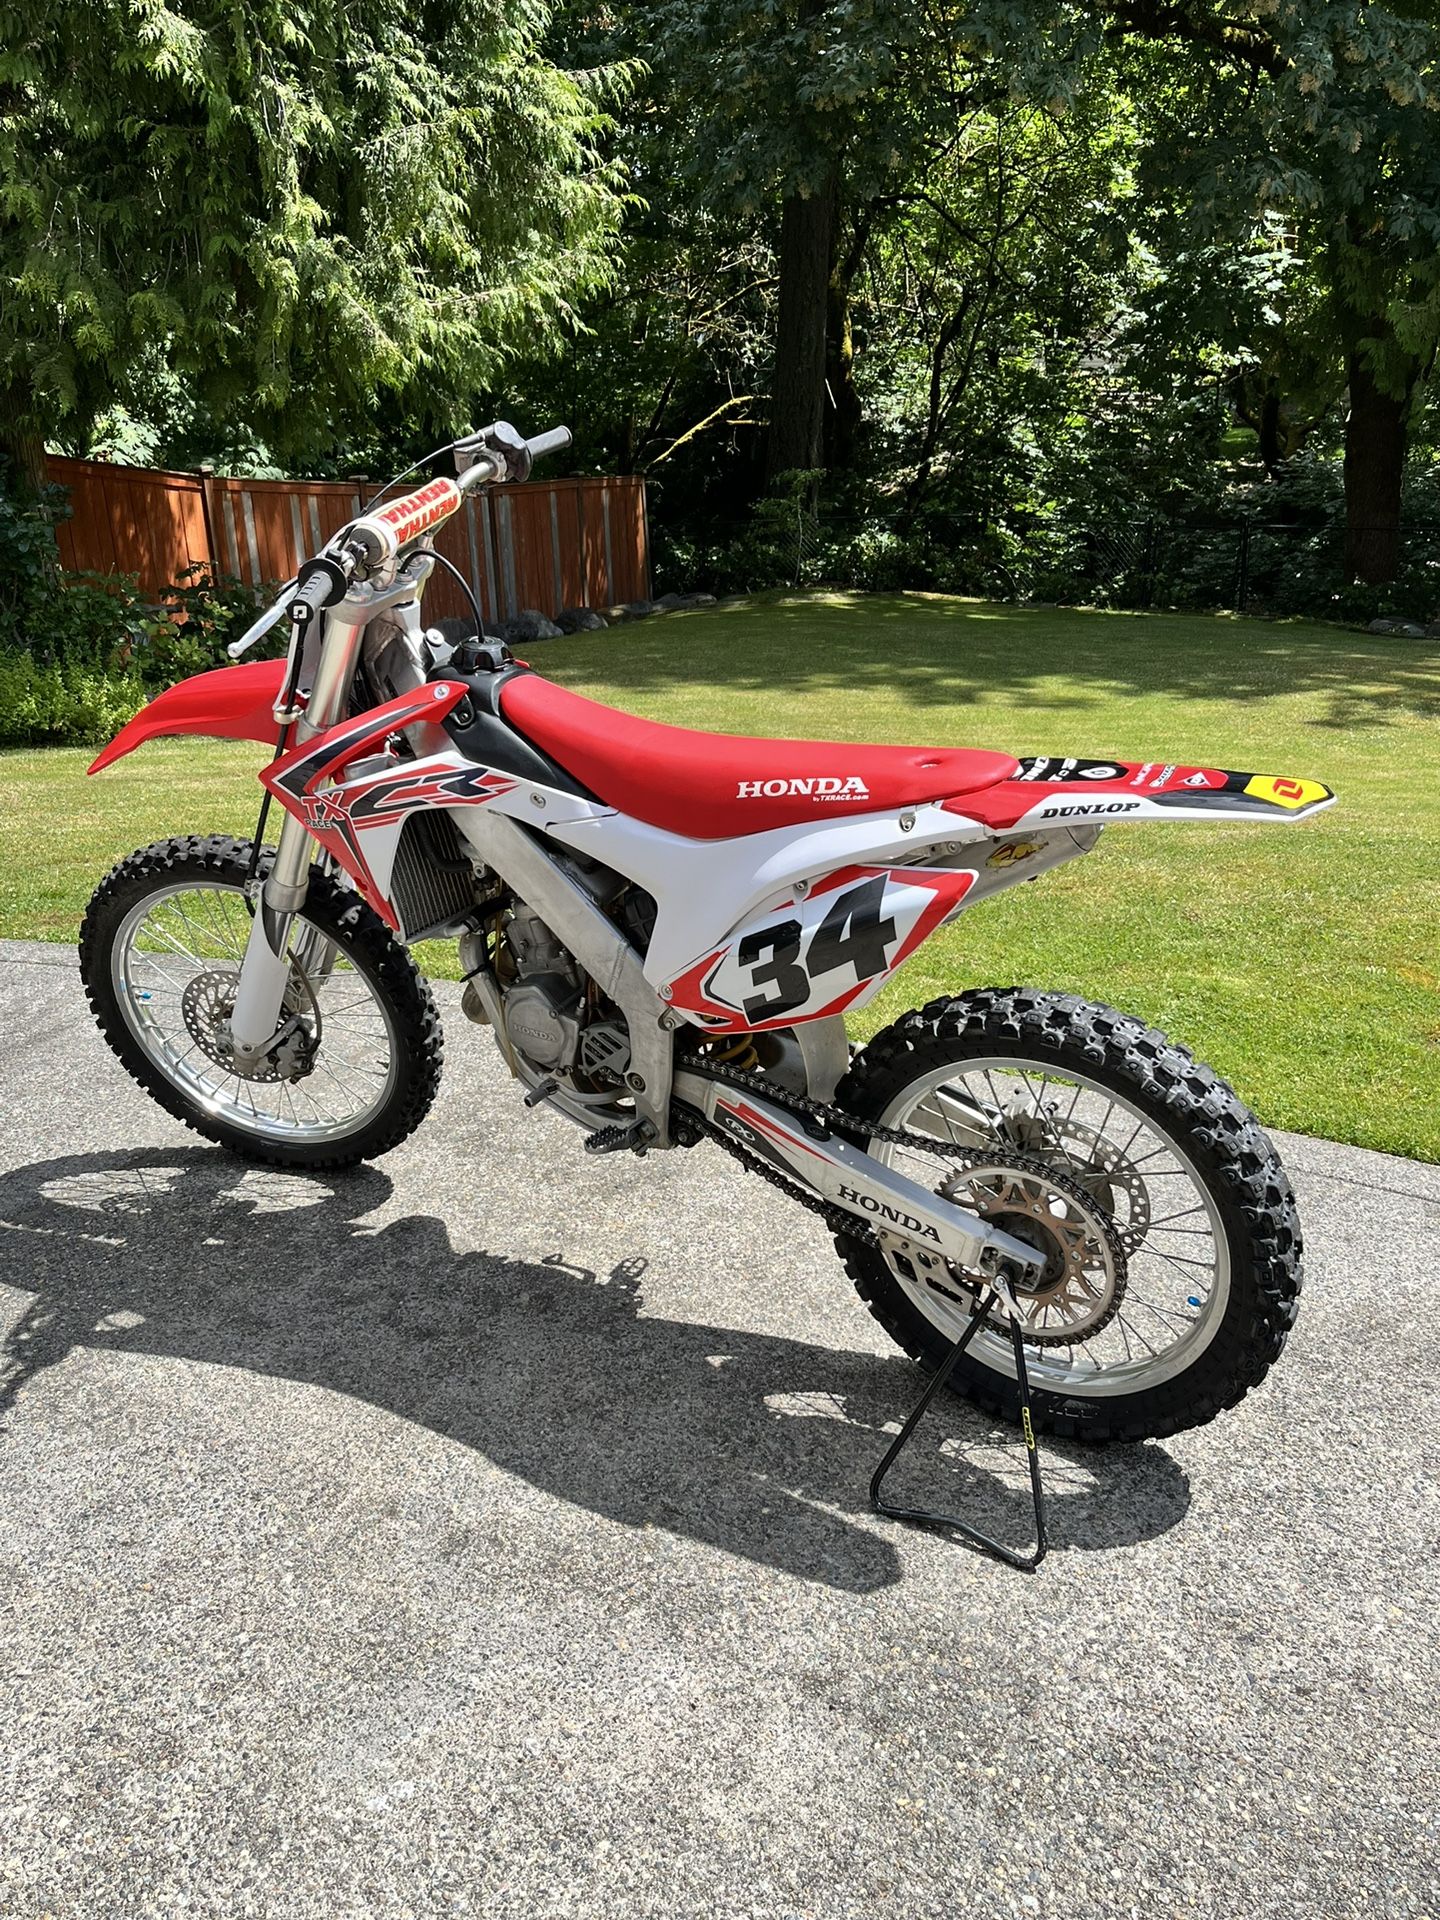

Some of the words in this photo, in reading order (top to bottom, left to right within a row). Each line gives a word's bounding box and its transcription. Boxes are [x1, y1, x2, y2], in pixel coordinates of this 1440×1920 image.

[395, 494, 458, 544] RENTHA
[736, 776, 870, 799] HONDA
[301, 791, 346, 822] TX
[1040, 803, 1141, 819] DUNLOP
[738, 873, 898, 1024] 34
[512, 1023, 557, 1041] HONDA
[837, 1183, 943, 1244] HONDA
